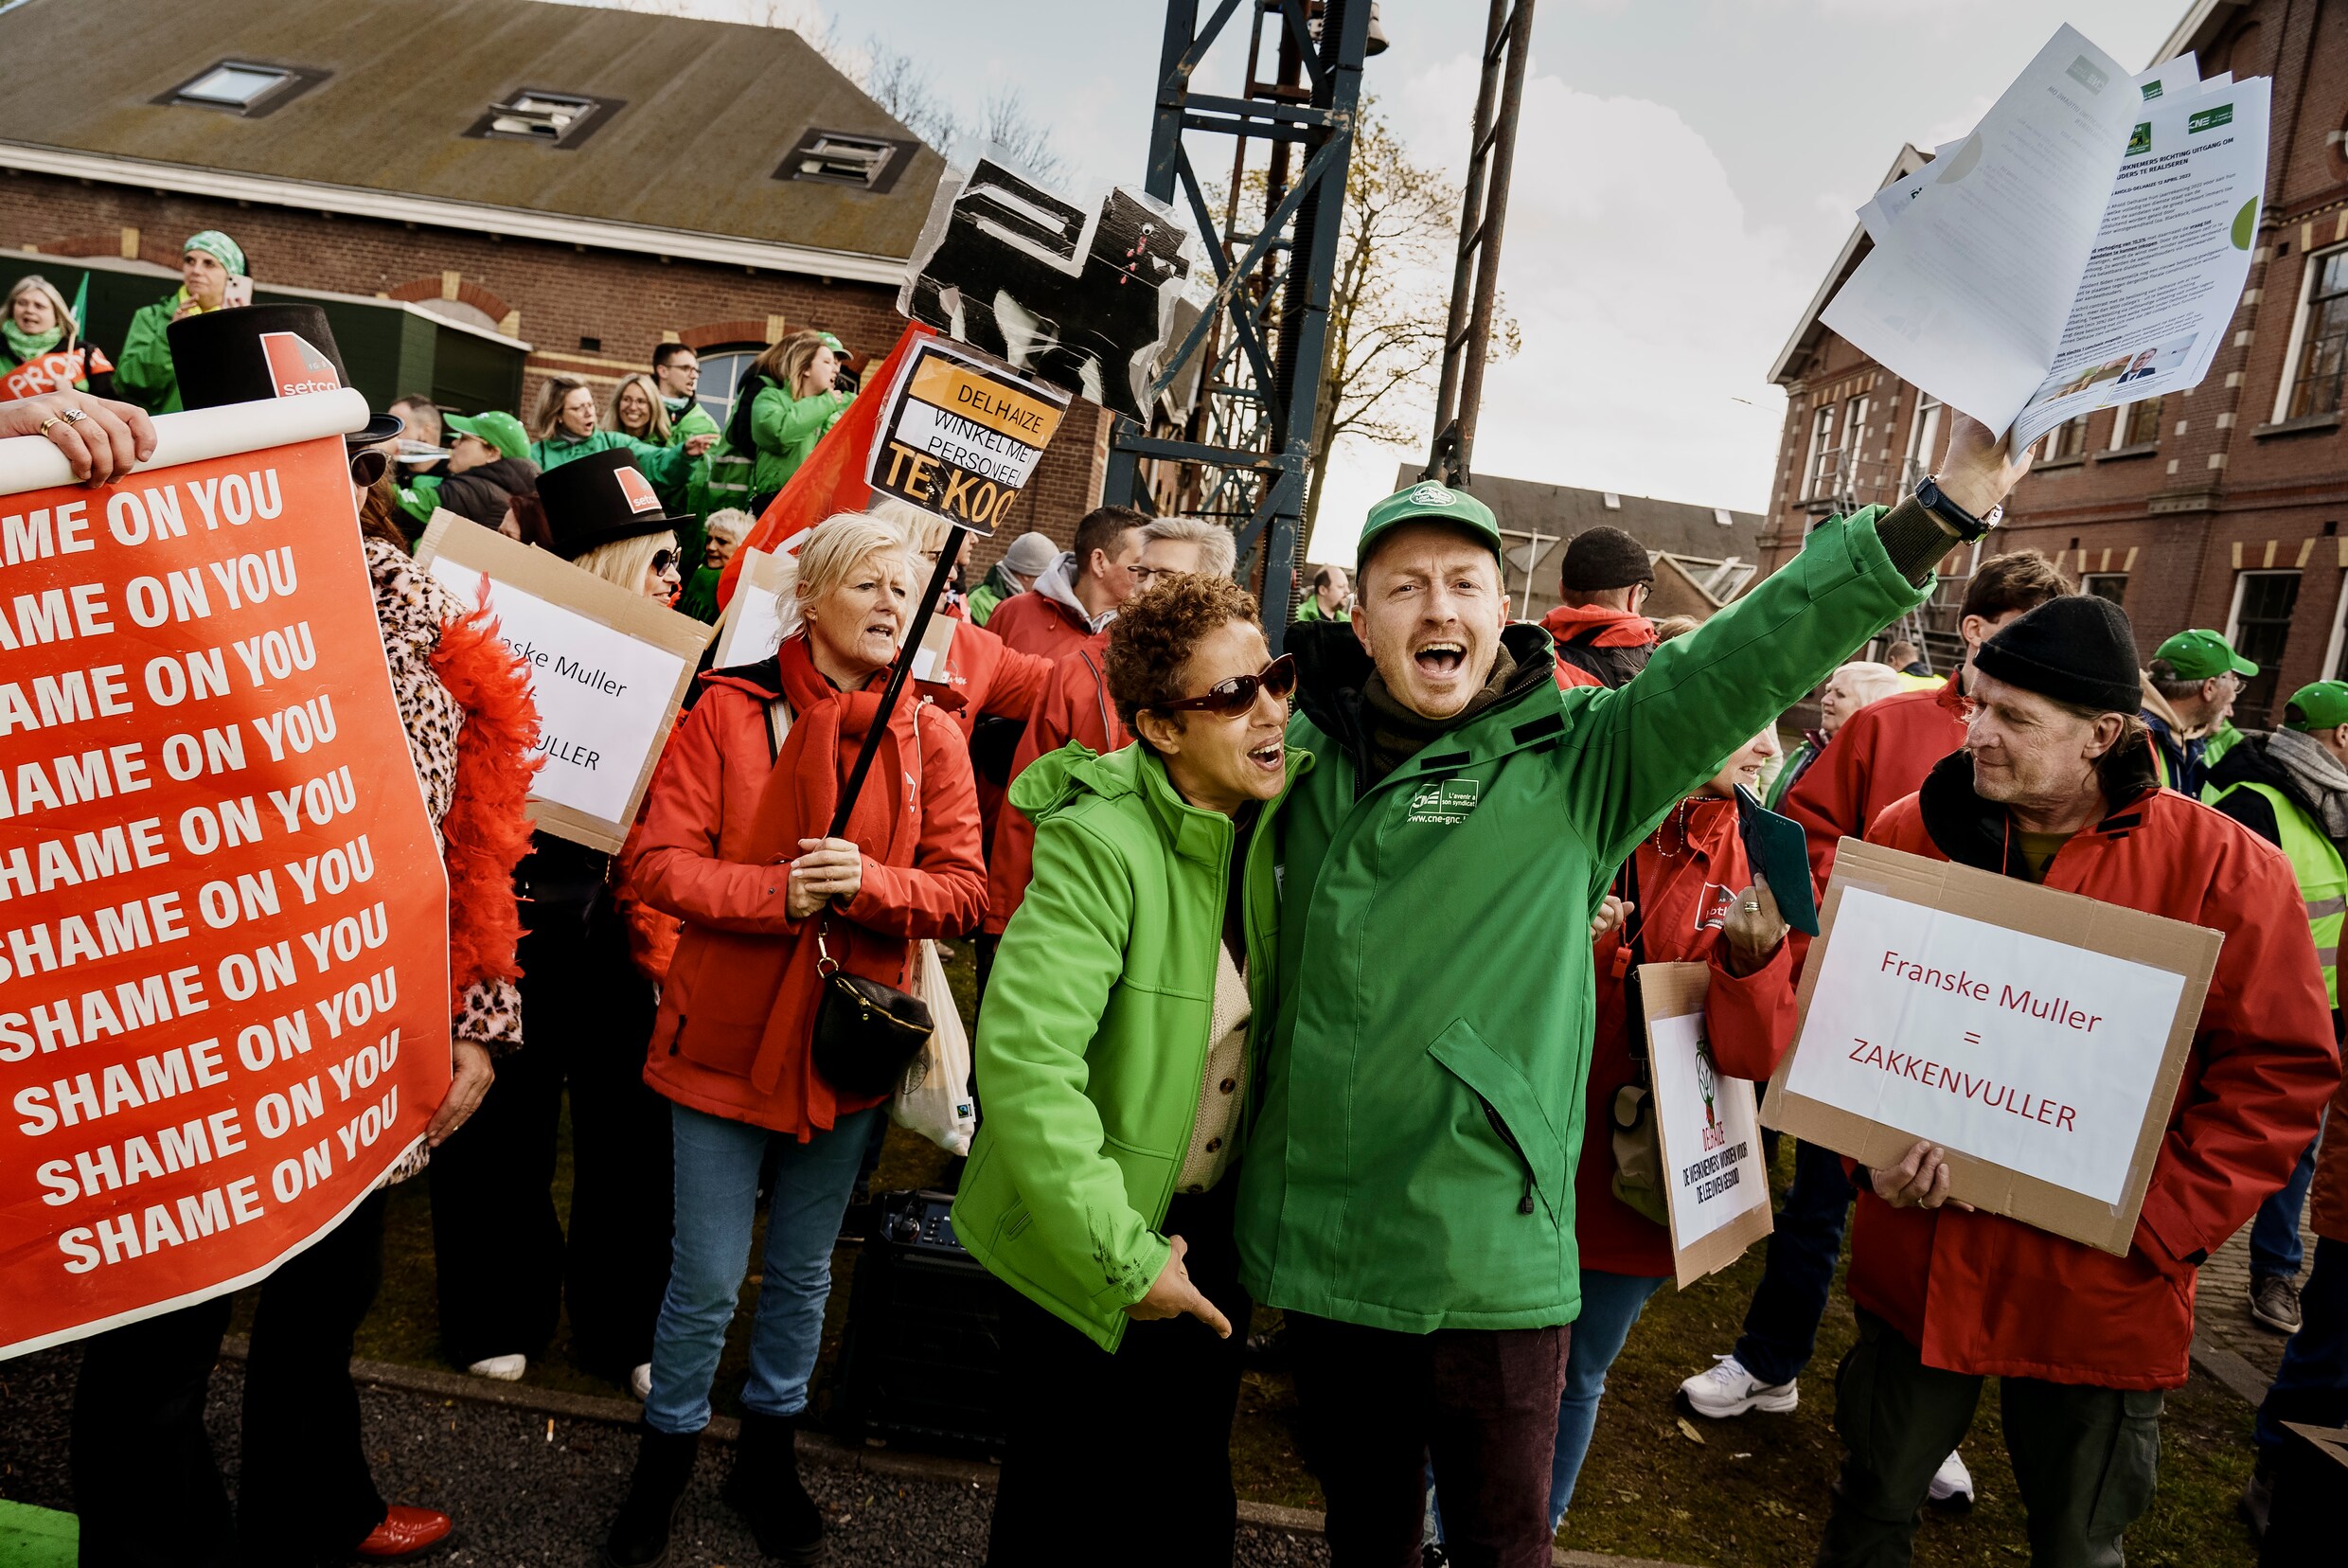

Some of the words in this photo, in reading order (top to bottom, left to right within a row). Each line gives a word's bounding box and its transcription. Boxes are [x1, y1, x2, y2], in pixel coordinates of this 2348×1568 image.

[2159, 149, 2190, 162] RICHTING
[2192, 140, 2221, 153] UITGANG
[2222, 136, 2233, 145] OM
[2189, 116, 2211, 129] CNE
[2148, 157, 2188, 172] REALISEREN
[935, 409, 1002, 454] WINKEL
[957, 384, 1044, 434] DELHAIZE
[886, 441, 940, 502] TE
[0, 501, 95, 567] ME
[107, 484, 187, 545] ON
[186, 469, 282, 530] YOU
[126, 567, 211, 627] ON
[209, 545, 297, 610] YOU
[145, 648, 230, 706] ON
[232, 621, 316, 688] YOU
[555, 656, 627, 697] Muller
[163, 724, 246, 781] ON
[252, 694, 336, 761] YOU
[180, 796, 262, 855] ON
[268, 765, 357, 834] YOU
[199, 869, 280, 929] ON
[285, 834, 374, 905] YOU
[0, 966, 209, 1062] SHAME
[218, 941, 296, 1002] ON
[301, 901, 388, 973] YOU
[1880, 951, 1989, 1002] Franske
[1999, 985, 2102, 1033] Muller
[13, 1038, 228, 1136] SHAME
[238, 1009, 311, 1072] ON
[315, 966, 397, 1040] YOU
[1848, 1039, 2077, 1131] ZAKKENVULLER
[36, 1108, 246, 1206] SHAME
[256, 1076, 324, 1139] ON
[329, 1028, 400, 1102] YOU
[58, 1176, 263, 1274] SHAME
[273, 1138, 331, 1203] ON
[337, 1085, 398, 1162] YOU
[1682, 1167, 1690, 1187] DE
[1696, 1185, 1704, 1204] DE
